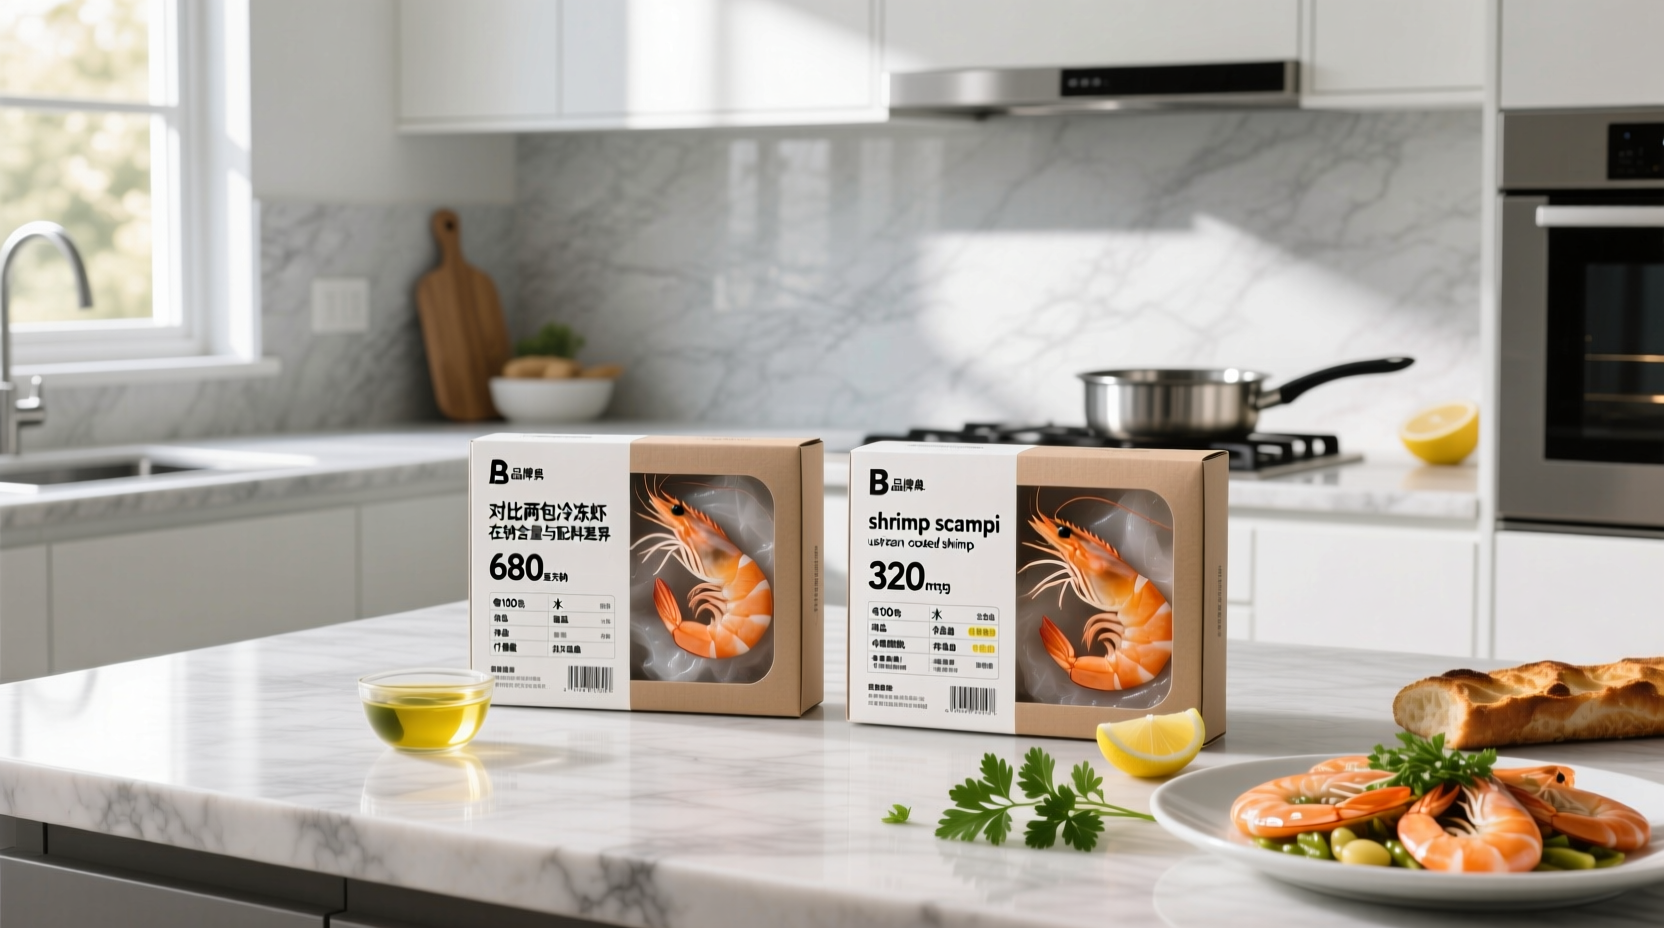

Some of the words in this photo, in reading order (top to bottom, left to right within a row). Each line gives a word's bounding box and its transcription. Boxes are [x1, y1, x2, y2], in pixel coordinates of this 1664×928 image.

[489, 459, 509, 484] B
[869, 468, 889, 495] B
[489, 500, 607, 523] 对比两包冷冻虾
[868, 511, 931, 536] shrimp
[935, 514, 1000, 538] scampi
[489, 553, 544, 581] 680
[868, 560, 925, 591] 320
